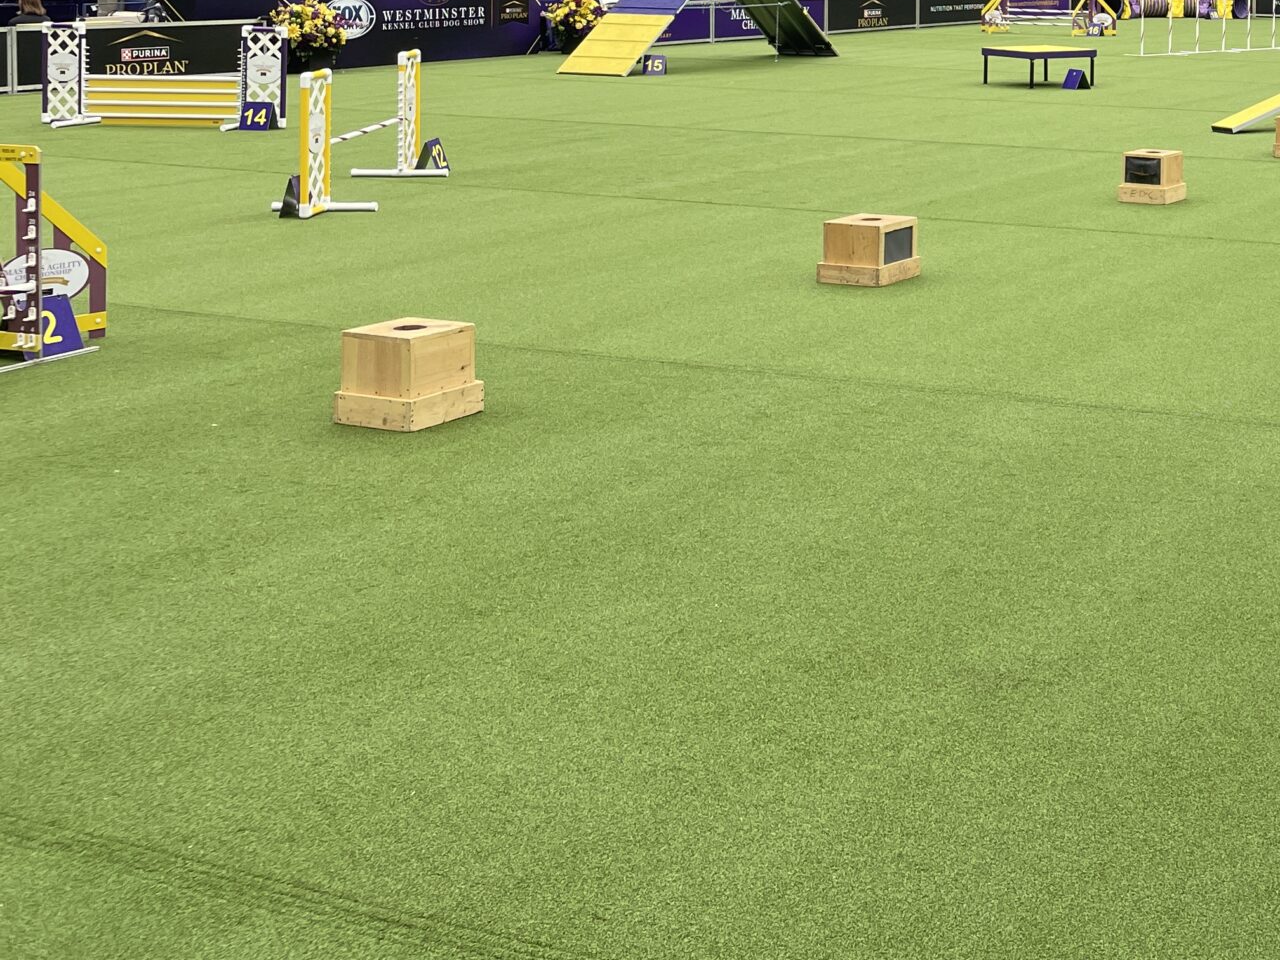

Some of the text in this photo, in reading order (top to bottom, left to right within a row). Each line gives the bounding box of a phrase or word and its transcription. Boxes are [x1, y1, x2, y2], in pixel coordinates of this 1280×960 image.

[382, 7, 485, 22] WESTMINSTER
[382, 18, 485, 31] KENNEL CLUB DOG SHOW
[857, 17, 888, 27] PRO PLAN
[133, 49, 167, 58] PURINA
[105, 60, 187, 75] PRO PLAN
[645, 59, 662, 71] 15
[245, 108, 267, 126] 14
[432, 144, 447, 169] 12
[47, 260, 81, 271] AGILITY
[41, 310, 63, 344] 2
